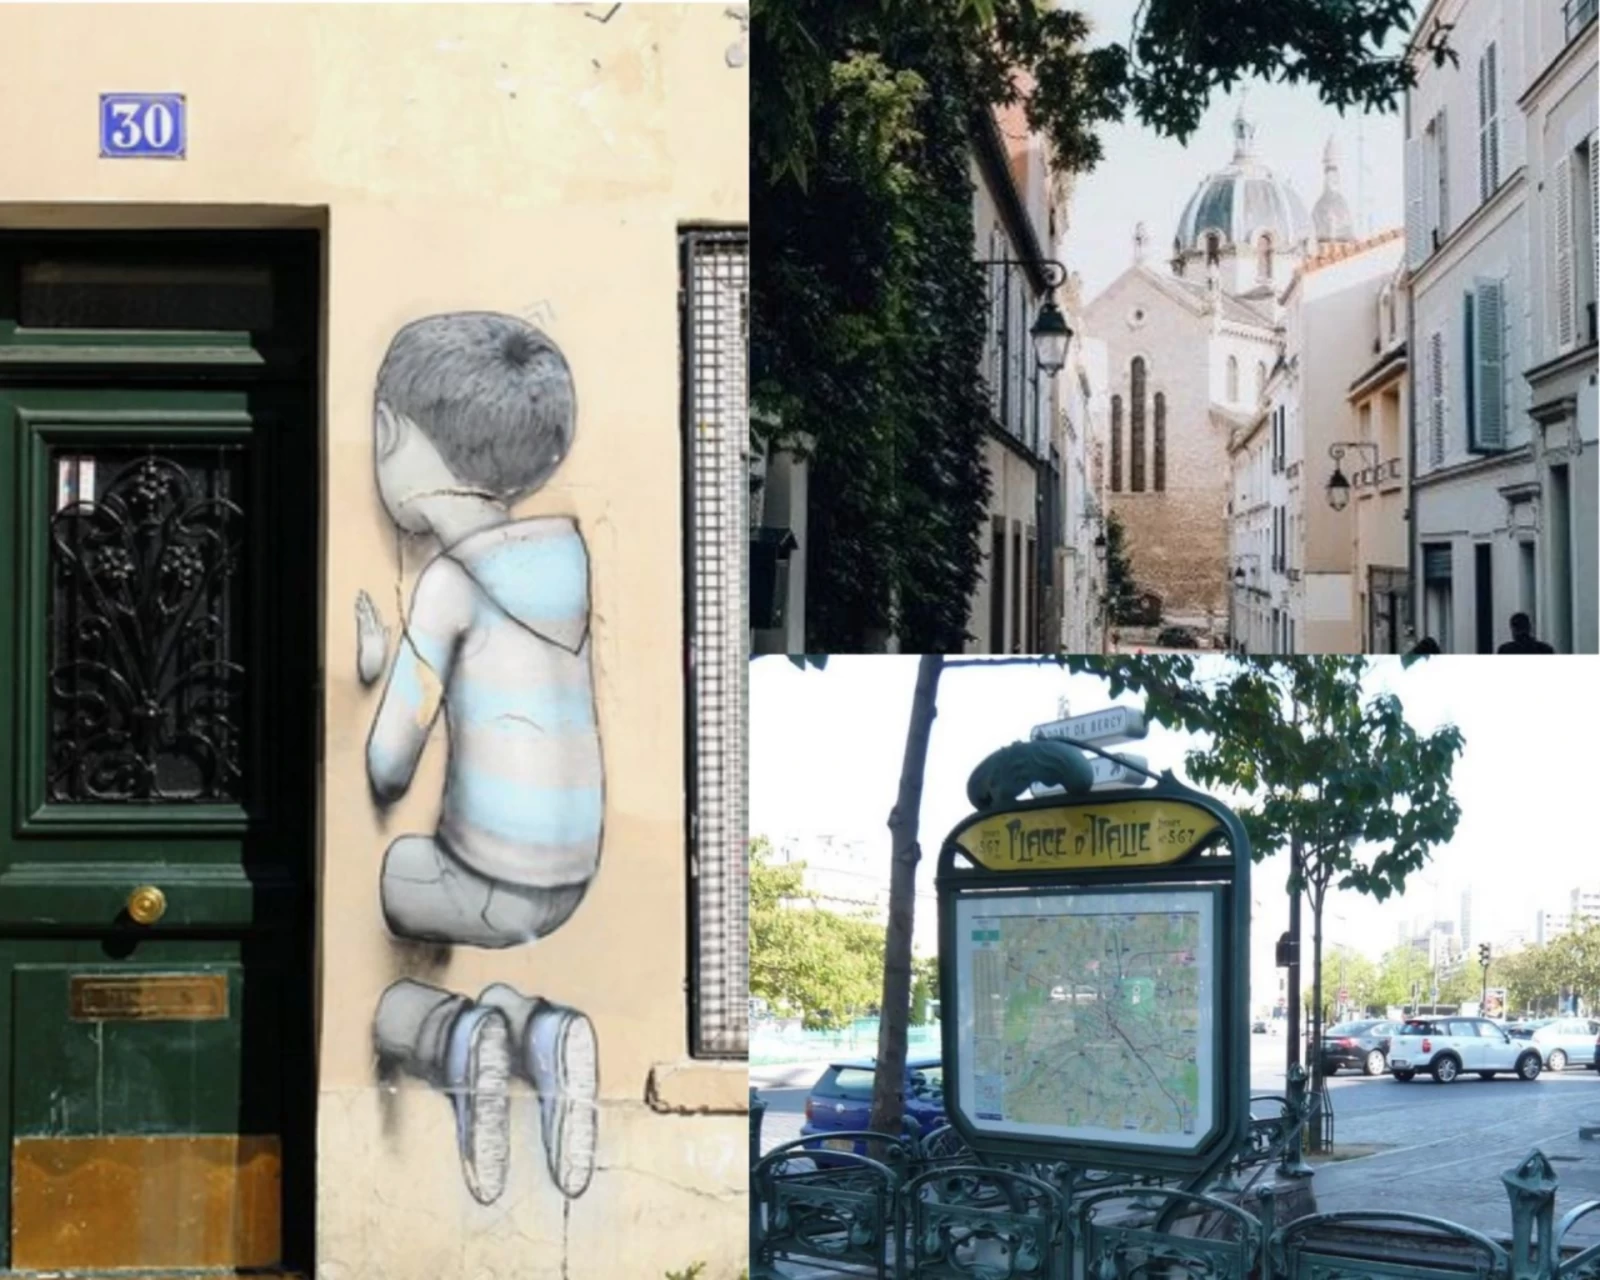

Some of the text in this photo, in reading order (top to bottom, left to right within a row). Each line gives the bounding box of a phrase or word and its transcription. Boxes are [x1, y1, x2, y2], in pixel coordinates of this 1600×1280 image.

[112, 103, 173, 148] 30
[1074, 722, 1086, 736] DE
[1091, 714, 1122, 732] BERCY
[1005, 818, 1067, 862] PLACE
